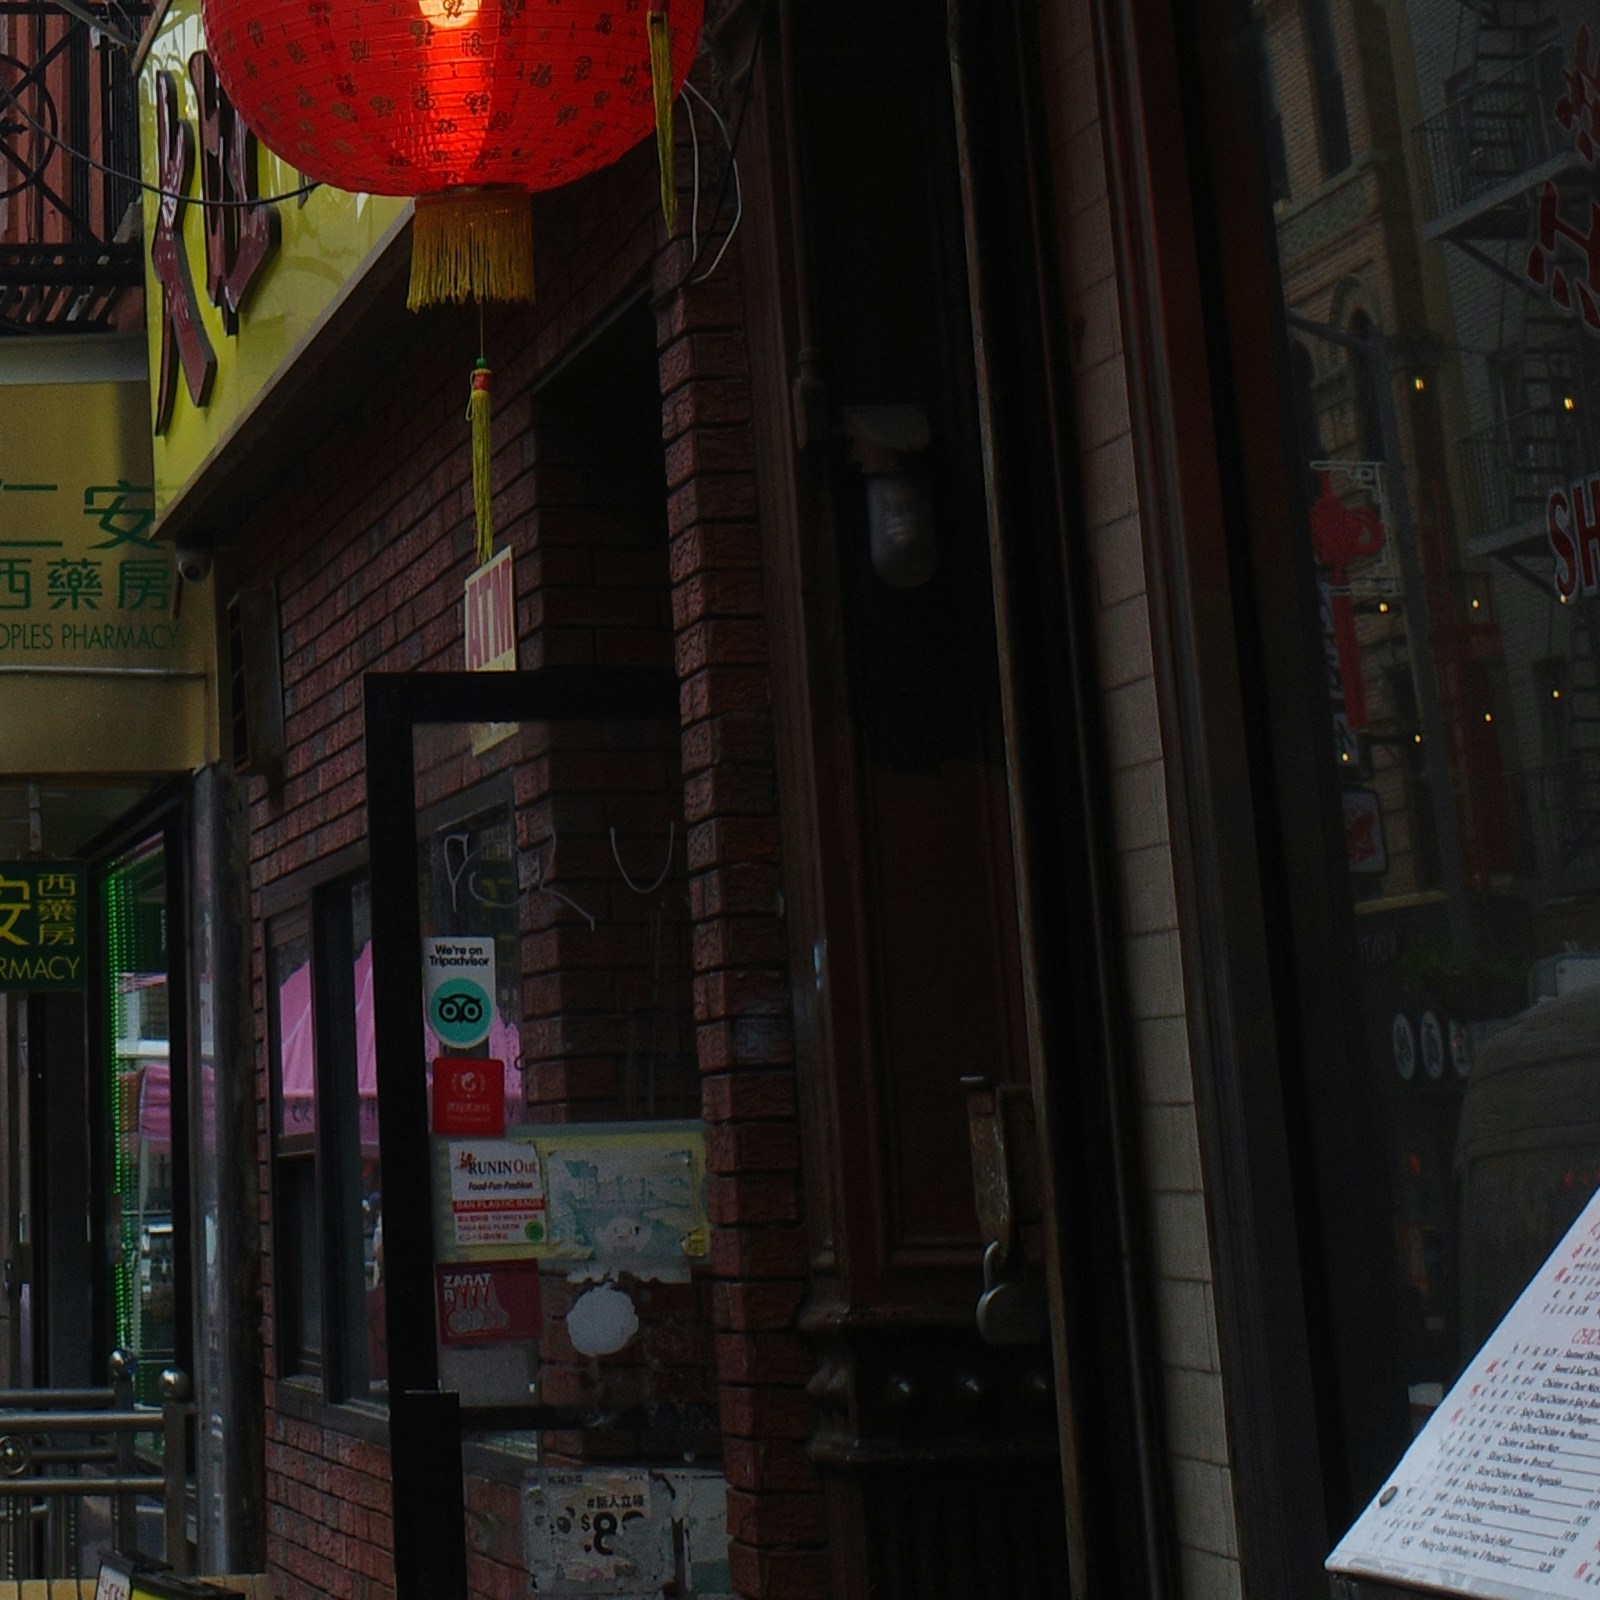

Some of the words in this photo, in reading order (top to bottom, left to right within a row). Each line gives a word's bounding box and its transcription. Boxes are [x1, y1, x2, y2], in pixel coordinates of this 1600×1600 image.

[61, 622, 181, 651] PHARMACY
[37, 873, 76, 947] 西藥房
[435, 944, 466, 955] We're
[469, 946, 483, 955] on
[429, 955, 490, 967] Tripadvisor
[443, 1273, 492, 1288] ZAGAT
